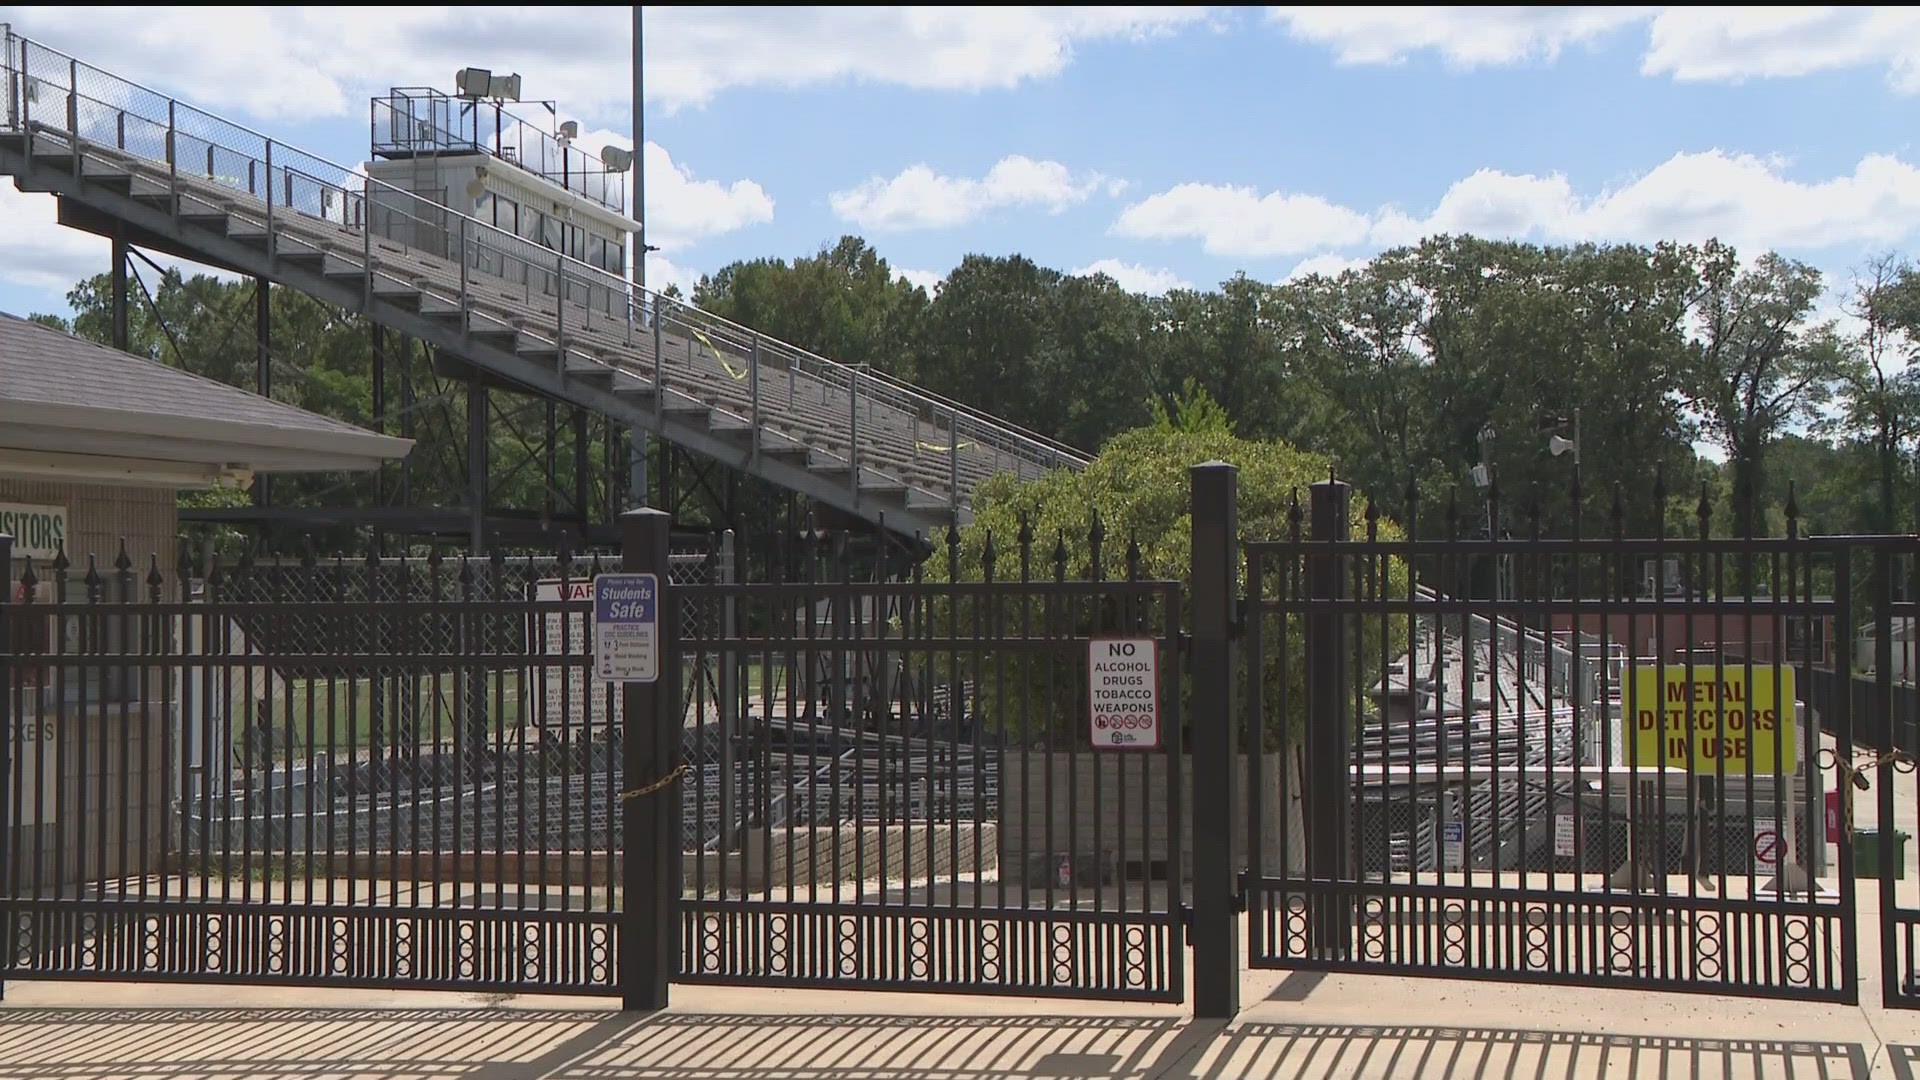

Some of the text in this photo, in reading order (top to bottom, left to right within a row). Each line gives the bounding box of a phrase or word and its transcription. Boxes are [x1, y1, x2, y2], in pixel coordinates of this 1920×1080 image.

[601, 586, 652, 600] Students
[609, 601, 645, 619] Safe
[613, 640, 619, 651] 3
[1109, 643, 1136, 657] NO
[1095, 662, 1151, 672] ALCOHOL
[1103, 676, 1143, 686] DRUGS
[1095, 689, 1152, 699] TOBACCO
[1667, 681, 1746, 702] METAL
[1093, 703, 1154, 713] WEAPONS
[1669, 737, 1747, 759] IN USE
